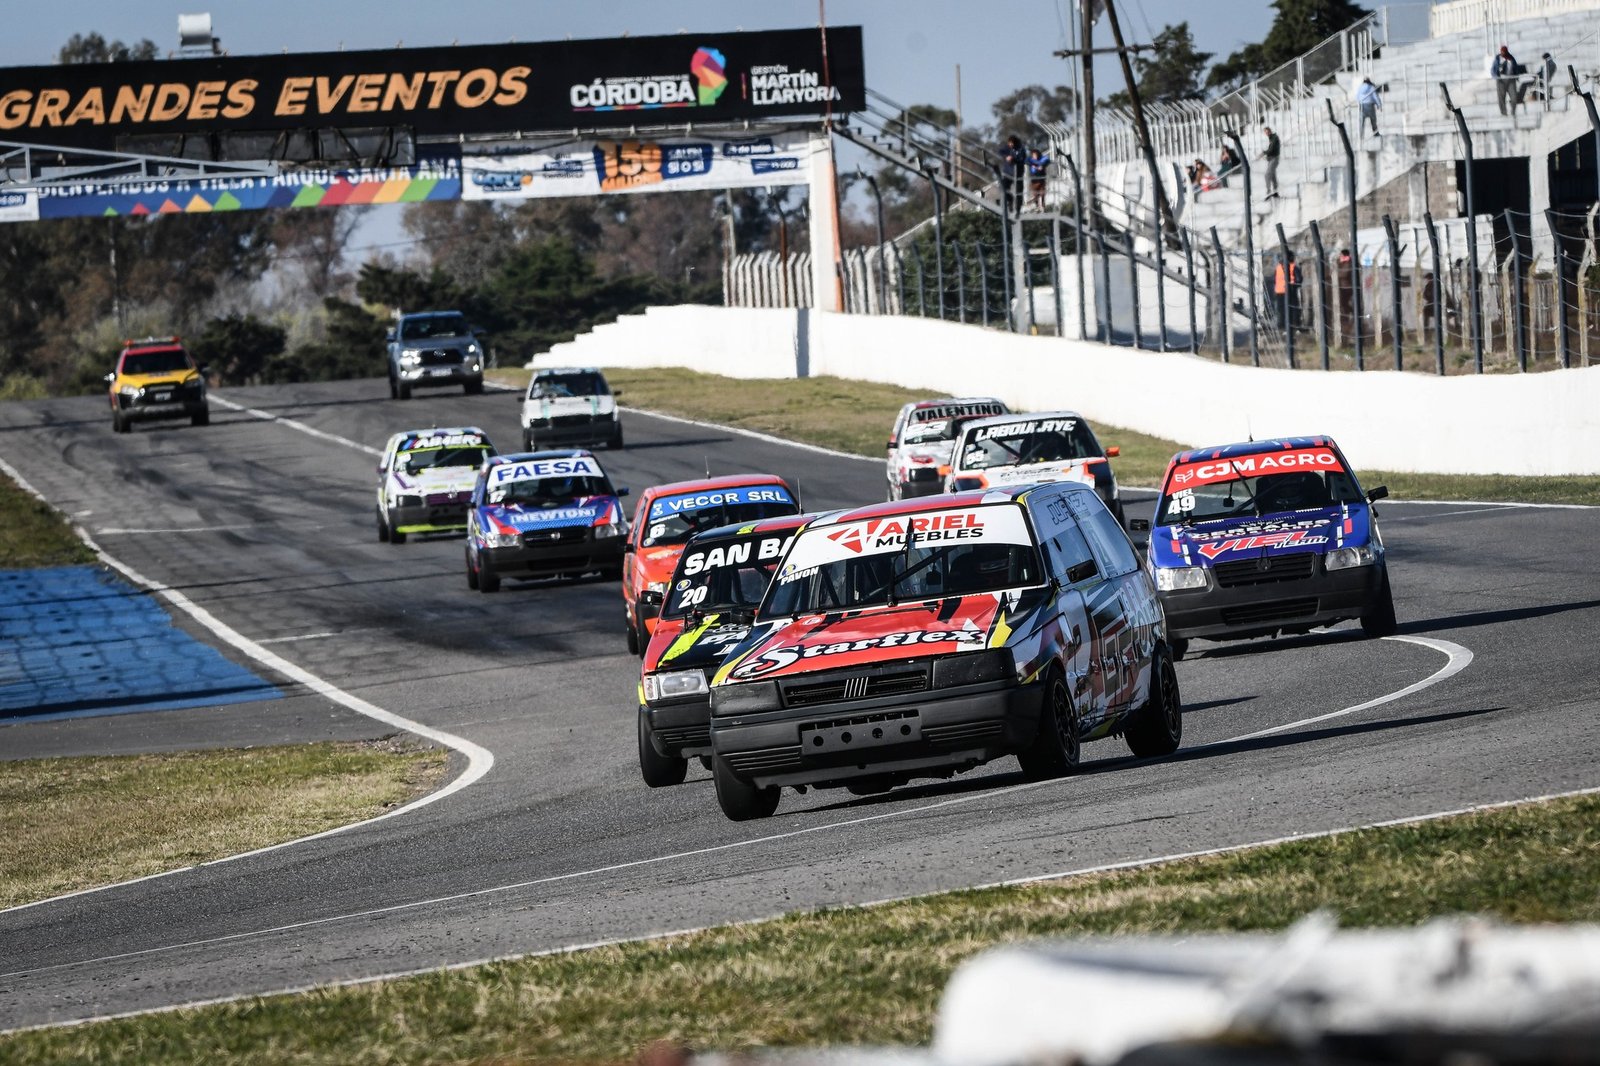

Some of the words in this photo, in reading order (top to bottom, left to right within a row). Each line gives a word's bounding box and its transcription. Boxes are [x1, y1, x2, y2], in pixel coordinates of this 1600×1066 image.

[751, 69, 818, 90] MARTÍN
[0, 77, 259, 131] GRANDES
[274, 65, 532, 117] EVENTOS
[570, 78, 696, 107] CÓRDOBA
[752, 85, 841, 105] LLARYORA
[915, 404, 1004, 422] VALENTINO
[497, 461, 592, 481] FAESA
[1196, 458, 1256, 479] CJM
[1260, 453, 1336, 469] AGRO
[668, 492, 740, 512] VECOR
[747, 490, 789, 502] SRL
[1167, 495, 1196, 515] 49
[880, 514, 985, 536] ARIEL
[875, 528, 984, 548] MUEBLES
[1198, 531, 1309, 560] VIEL
[684, 541, 751, 576] SAN
[780, 566, 820, 586] PAVON
[678, 585, 708, 609] 20
[731, 630, 981, 679] Starflex
